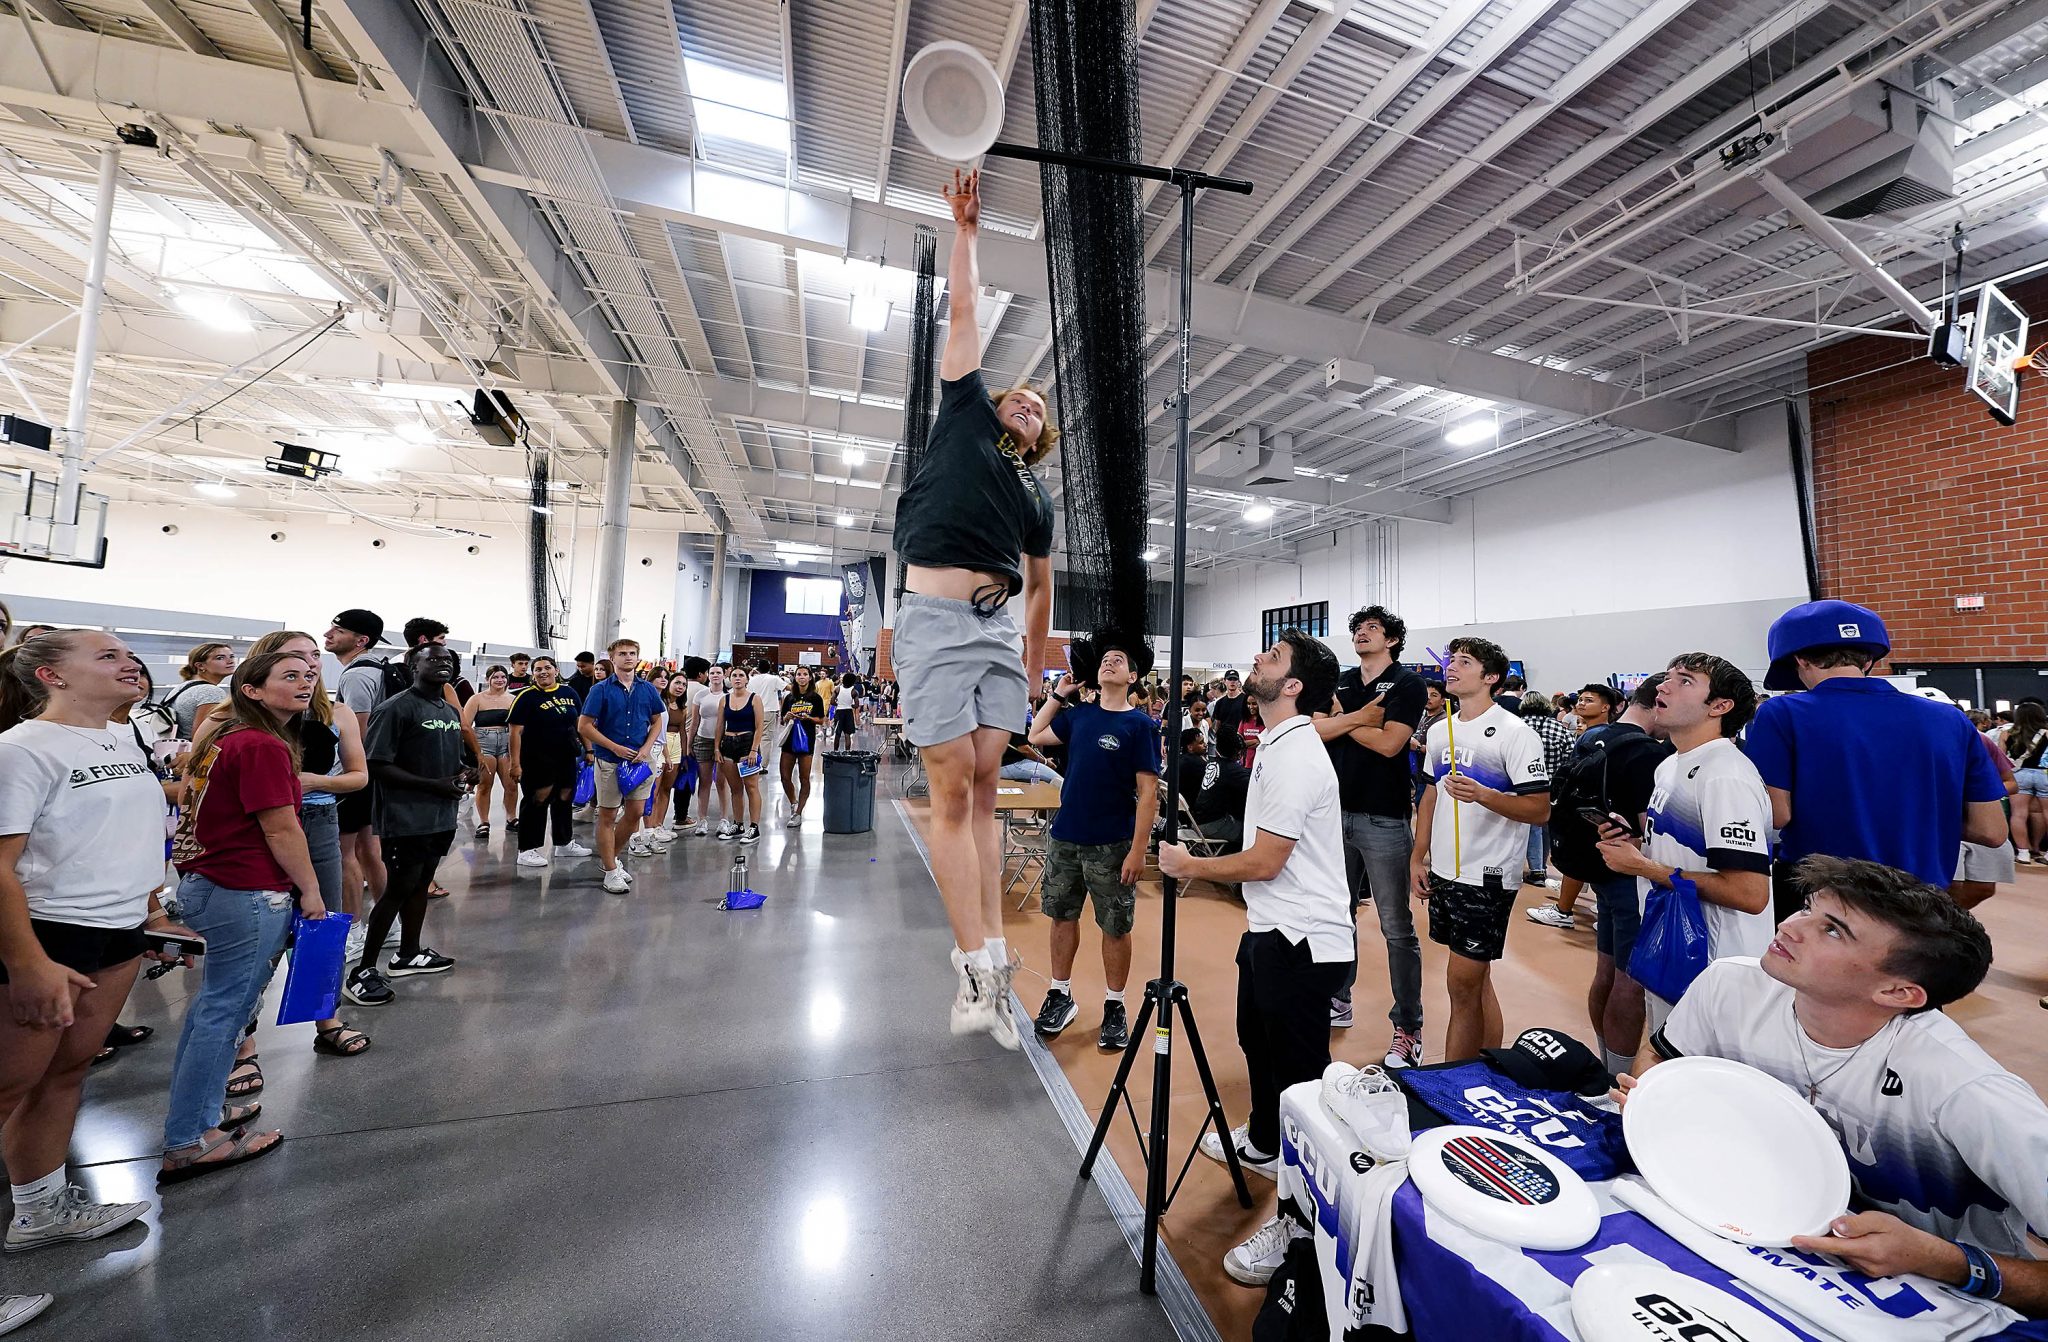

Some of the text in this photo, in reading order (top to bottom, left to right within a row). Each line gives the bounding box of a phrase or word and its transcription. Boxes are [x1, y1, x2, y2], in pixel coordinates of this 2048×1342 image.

[1441, 746, 1475, 768] GCU
[89, 763, 153, 779] FOOTBA
[1720, 827, 1756, 842] GCU
[1725, 839, 1753, 847] ULTIMATE
[1517, 1039, 1548, 1061] ULTIMATE
[1521, 1030, 1567, 1061] GCU
[1463, 1085, 1587, 1149] GCU
[1284, 1115, 1338, 1206] GCU
